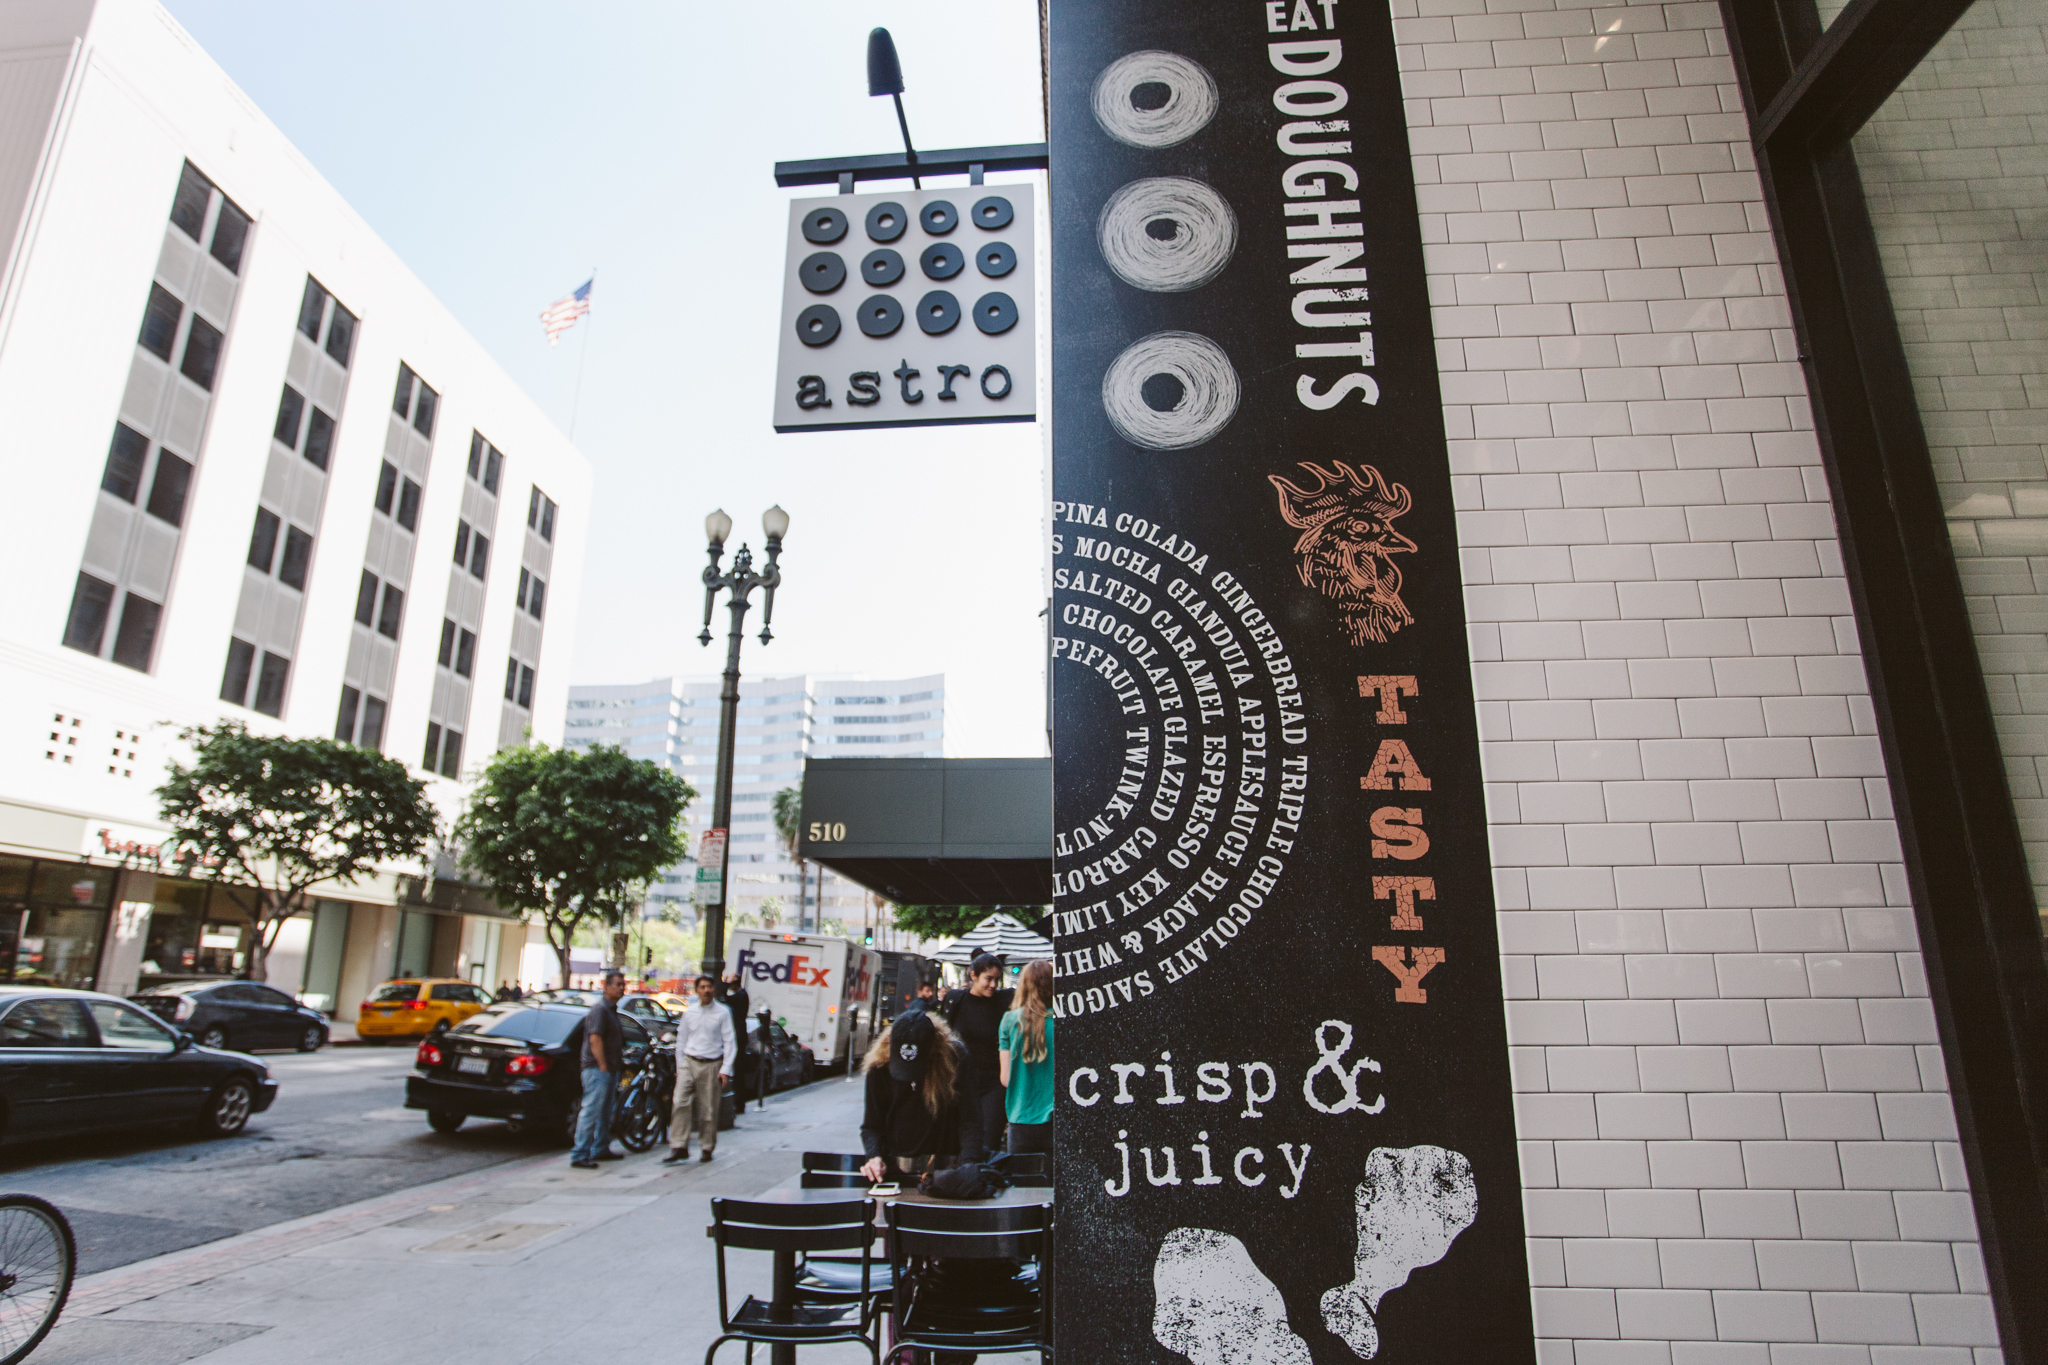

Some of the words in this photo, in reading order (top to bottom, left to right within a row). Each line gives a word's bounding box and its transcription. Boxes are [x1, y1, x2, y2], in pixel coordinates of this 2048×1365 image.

[1266, 0, 1338, 33] EAT
[1267, 39, 1380, 410] DOUGHNUTS
[795, 358, 1012, 410] astro
[1052, 501, 1108, 528] PINA
[1115, 513, 1209, 575] COLADA
[1053, 568, 1152, 616] SALTED
[1074, 536, 1162, 585] MOCHA
[1063, 603, 1184, 712] CHOCOLATE
[1151, 610, 1225, 725] CARAMEL
[1166, 578, 1254, 689] GIANDUIA
[1211, 571, 1308, 744] GINGERBREAD
[1052, 637, 1146, 715] PEFRUIT
[1056, 726, 1150, 857] TWINK-NUT
[1150, 717, 1188, 821] GLAZED
[1167, 735, 1227, 870] ESPRESSO
[1215, 697, 1266, 867] APPLESAUCE
[1266, 755, 1308, 855] TRIPLE
[808, 821, 846, 841] 510
[1053, 826, 1157, 897] CARROT
[1357, 675, 1446, 1004] TASTY
[1116, 867, 1171, 917] KEY
[1143, 866, 1229, 945] BLACK
[1158, 855, 1283, 984] CHOCOLATE
[737, 949, 831, 988] FedEx
[1120, 931, 1144, 954] &
[1053, 970, 1155, 1019] SAIGON
[1069, 1051, 1276, 1118] crisp
[1303, 1019, 1385, 1114] &
[1105, 1129, 1311, 1199] juicy
